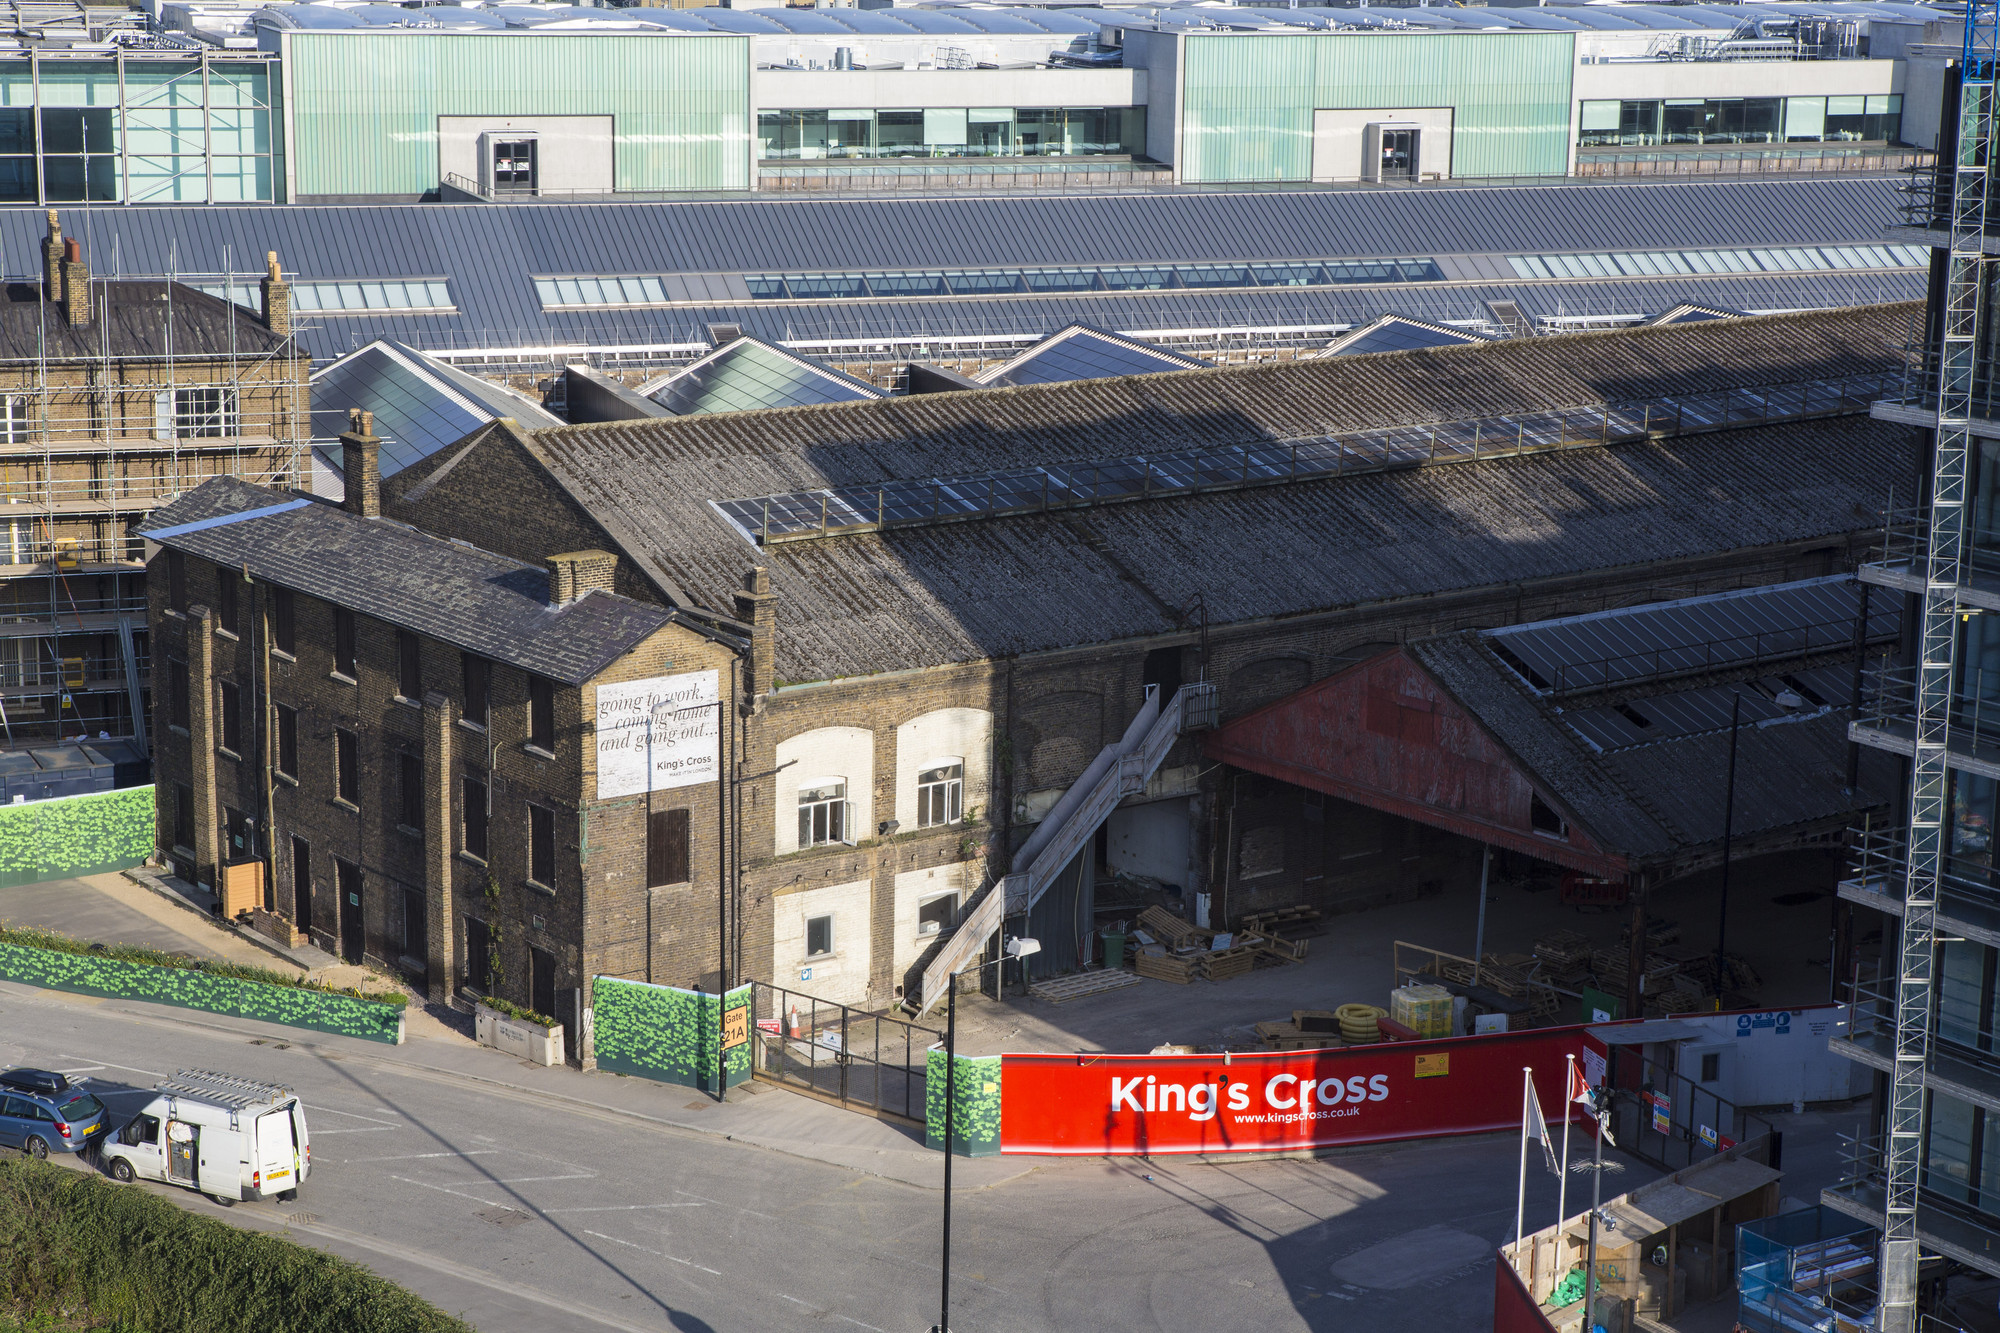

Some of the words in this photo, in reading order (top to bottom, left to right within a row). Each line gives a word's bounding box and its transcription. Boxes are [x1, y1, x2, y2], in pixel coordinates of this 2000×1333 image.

[600, 694, 643, 719] going
[647, 692, 660, 706] to
[615, 713, 667, 730] coming
[600, 731, 630, 751] and
[635, 730, 678, 752] going
[657, 758, 684, 771] King's
[686, 755, 712, 766] Cross
[725, 1012, 743, 1024] Gate
[724, 1025, 744, 1042] 21A
[1111, 1074, 1250, 1121] King's
[1265, 1073, 1389, 1110] Cross
[1234, 1105, 1360, 1124] www.kingscross.co.uk
